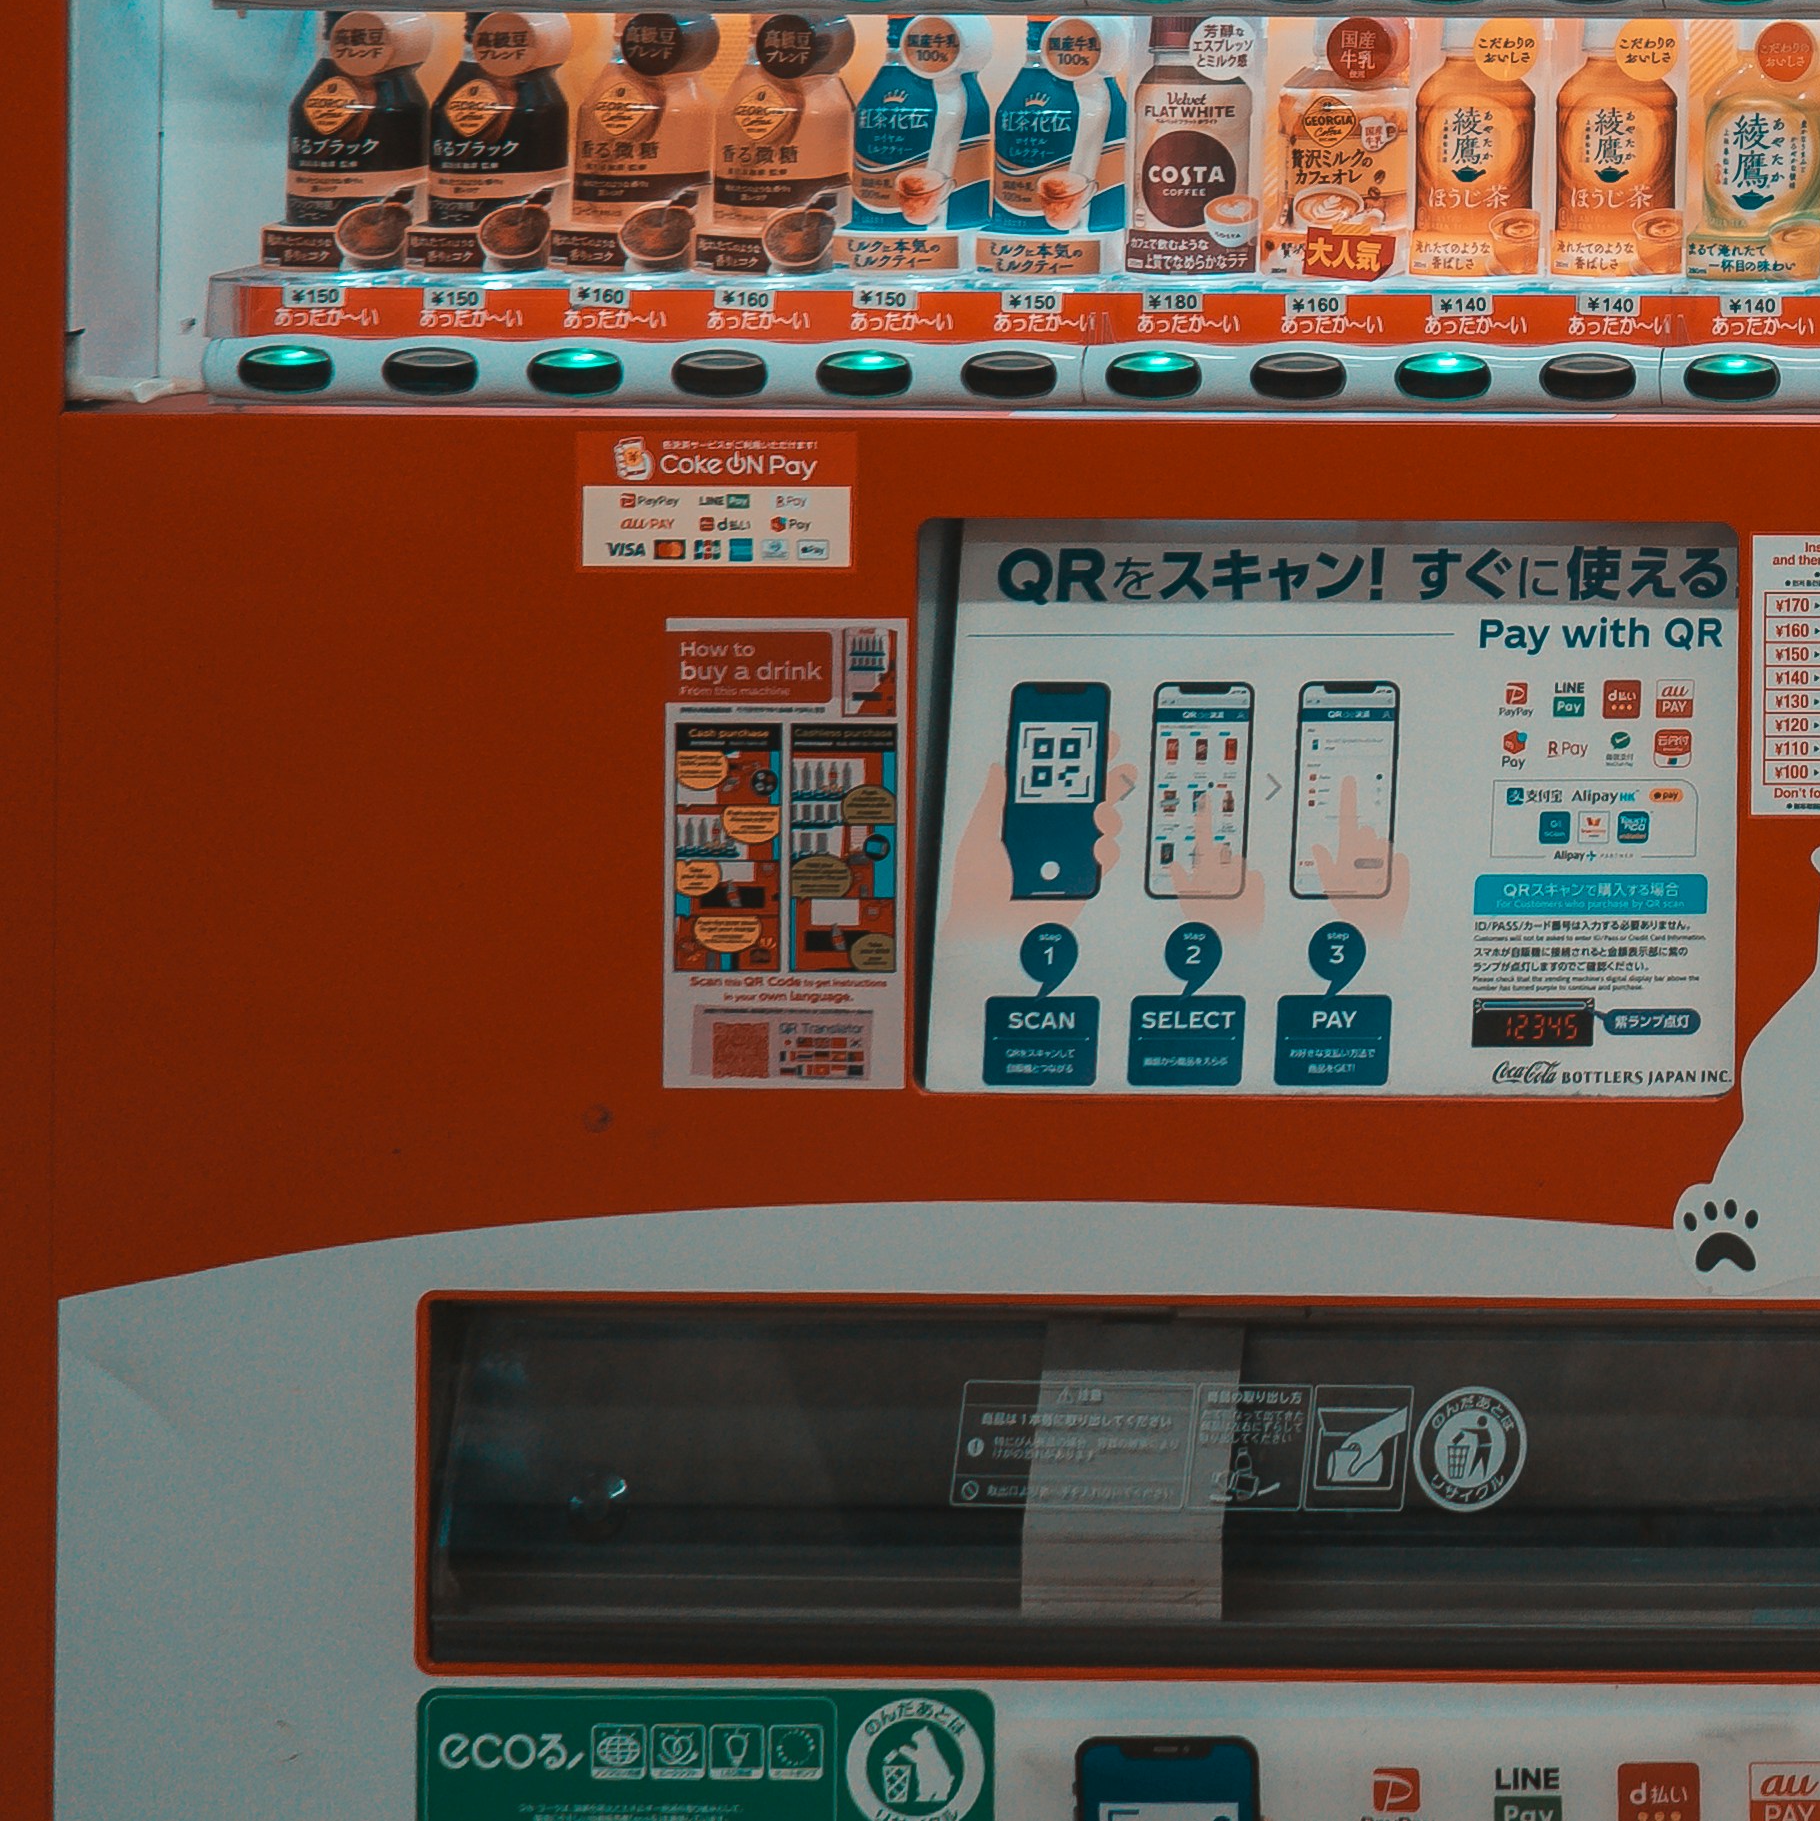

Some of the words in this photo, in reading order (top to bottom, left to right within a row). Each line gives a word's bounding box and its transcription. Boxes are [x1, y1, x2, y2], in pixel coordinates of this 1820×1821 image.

[1144, 104, 1178, 119] FLAT
[1183, 104, 1235, 119] WHITE
[1147, 162, 1226, 185] COSTA
[1162, 187, 1208, 198] COFFEE
[1427, 185, 1508, 210] ほうじ茶
[1307, 237, 1384, 269] 大人気
[1149, 293, 1198, 310] ¥180
[997, 546, 1386, 605] QRをスキャン!
[1774, 598, 1810, 614] ¥170
[1478, 619, 1552, 654] Pay
[1562, 618, 1650, 648] with
[1664, 619, 1724, 650] QR
[680, 640, 728, 659] How
[733, 641, 755, 658] to
[680, 660, 726, 685] buy
[731, 666, 749, 680] a
[754, 660, 822, 681] drink
[1774, 764, 1809, 780] ¥100
[1008, 1011, 1076, 1030] SCAN
[1141, 1011, 1236, 1030] SELECT
[1312, 1010, 1357, 1029] PAY
[1560, 1068, 1644, 1084] BOTTLERS
[1646, 1068, 1698, 1084] JAPAN
[1700, 1068, 1732, 1084] INC.
[1494, 1766, 1560, 1791] LINE
